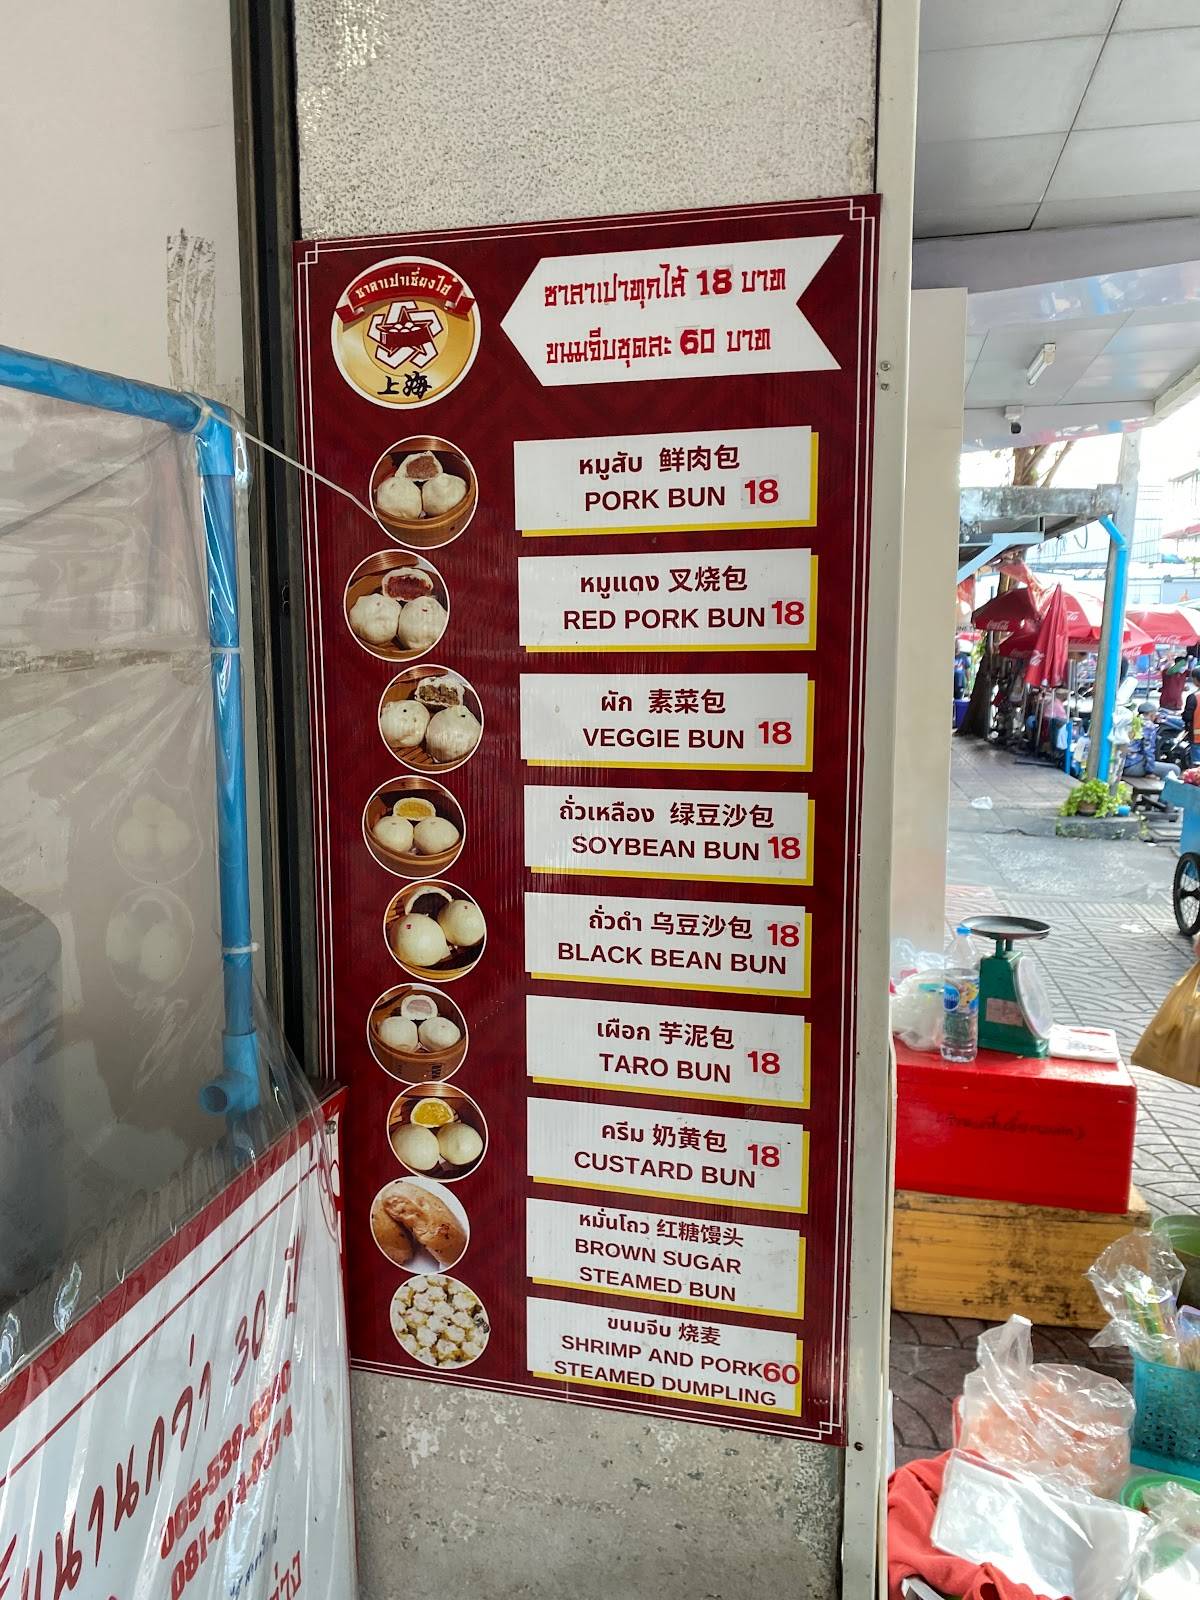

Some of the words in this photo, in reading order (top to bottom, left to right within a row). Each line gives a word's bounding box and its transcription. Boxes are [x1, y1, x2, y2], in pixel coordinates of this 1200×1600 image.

[697, 268, 732, 297] 18
[741, 267, 788, 293] บาท
[680, 328, 714, 356] 60
[727, 328, 772, 354] บาท
[377, 370, 432, 400] 上海
[579, 452, 643, 481] หมูสับ
[659, 444, 740, 473] 鲜肉包
[584, 489, 659, 512] PORK
[668, 486, 725, 507] BUN
[744, 479, 779, 505] 18
[580, 573, 659, 600] หมูแดง
[668, 566, 748, 593] 叉烧包
[564, 610, 616, 630] RED
[625, 608, 698, 630] PORK
[708, 607, 765, 628] BUN
[771, 600, 805, 626] 18
[601, 690, 632, 712] ผัก
[648, 688, 726, 714] 素菜包
[582, 728, 680, 748] VEGGIE
[688, 729, 744, 749] BUN
[758, 721, 792, 745] 18
[559, 794, 654, 823] ถั่วเหลือง
[670, 802, 774, 829] 绿豆沙包
[572, 836, 695, 859] SOYBEAN
[704, 841, 759, 861] BUN
[768, 836, 801, 860] 18
[589, 904, 642, 931] ถั่วดำ
[650, 912, 752, 940] 乌豆沙包
[767, 923, 800, 947] 18
[557, 942, 643, 965] BLACK
[650, 948, 721, 971] BEAN
[730, 953, 787, 975] BUN
[597, 1018, 650, 1041] เผือก
[659, 1021, 735, 1050] 芋泥包
[599, 1053, 669, 1077] TARO
[677, 1061, 731, 1084] BUN
[747, 1051, 781, 1075] 18
[601, 1121, 644, 1143] ครีม
[652, 1123, 727, 1153] 奶黄包
[574, 1150, 693, 1182] CUSTARD
[701, 1166, 755, 1188] BUN
[747, 1143, 780, 1168] 18
[579, 1208, 650, 1234] หมั่นโถว
[656, 1218, 744, 1248] 红糖馒头
[575, 1238, 656, 1264] BROWN
[663, 1249, 741, 1275] SUGAR
[579, 1266, 682, 1295] STEAMED
[689, 1281, 736, 1302] BUN
[231, 1290, 267, 1386] 30
[607, 1315, 671, 1338] ขนมจีบ
[678, 1321, 721, 1346] 烧麦
[561, 1334, 642, 1359] SHRIMP
[648, 1347, 694, 1368] AND
[701, 1355, 764, 1379] PORK
[762, 1362, 801, 1385] 60
[554, 1359, 655, 1388] STEAMED
[662, 1376, 777, 1406] DUMPLING
